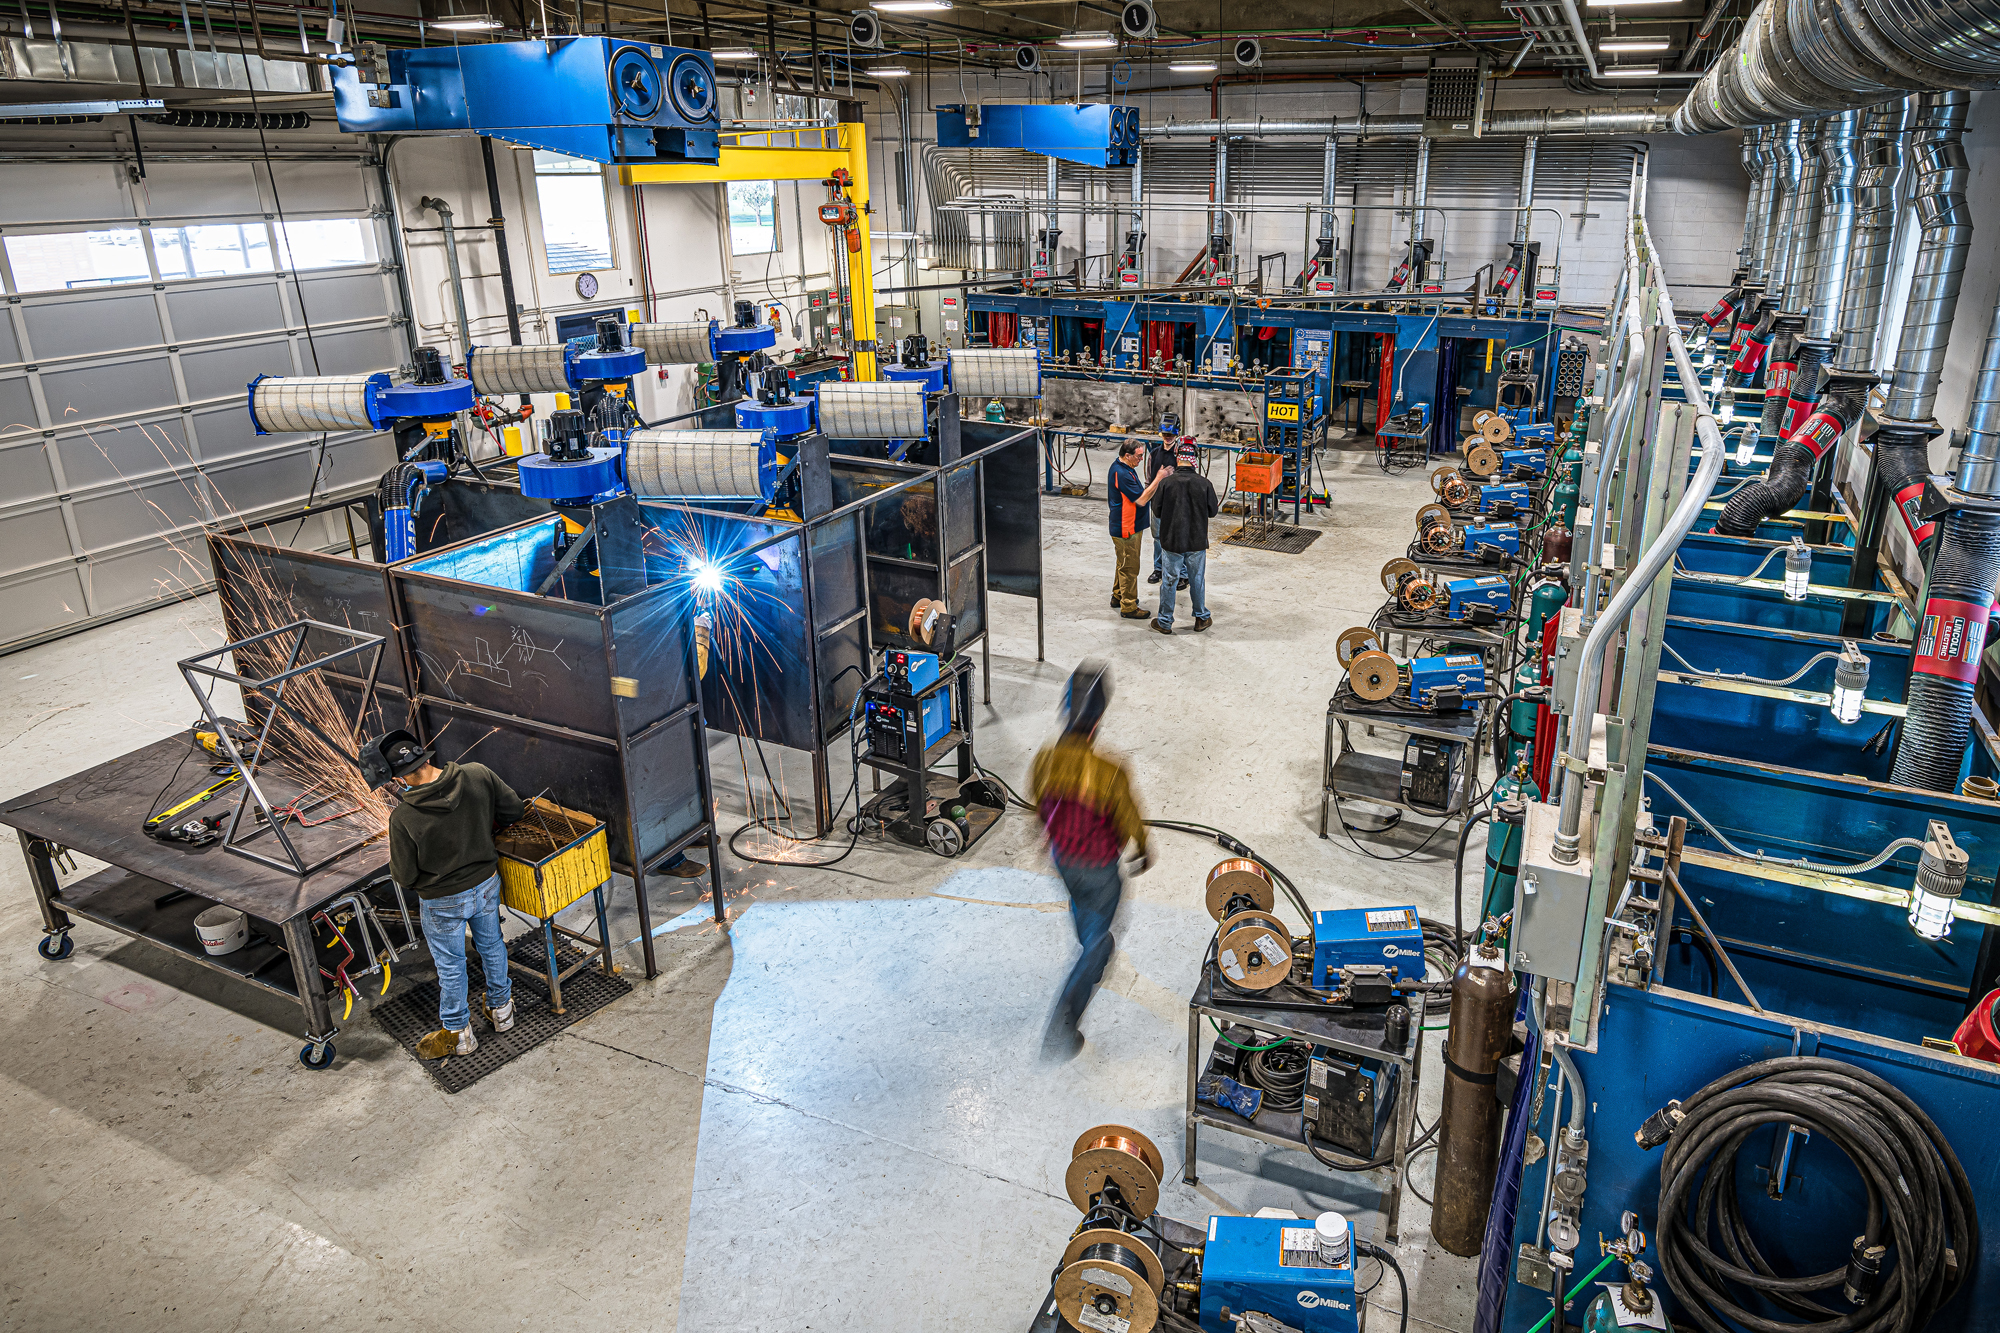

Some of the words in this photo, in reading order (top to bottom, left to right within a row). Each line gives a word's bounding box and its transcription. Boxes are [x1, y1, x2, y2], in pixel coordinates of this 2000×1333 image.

[1270, 405, 1296, 417] HOT
[1940, 625, 1952, 657] ELECTRIC
[1949, 619, 1964, 655] LINCOLN
[1398, 949, 1421, 957] Miller
[1320, 1297, 1351, 1311] Miller
